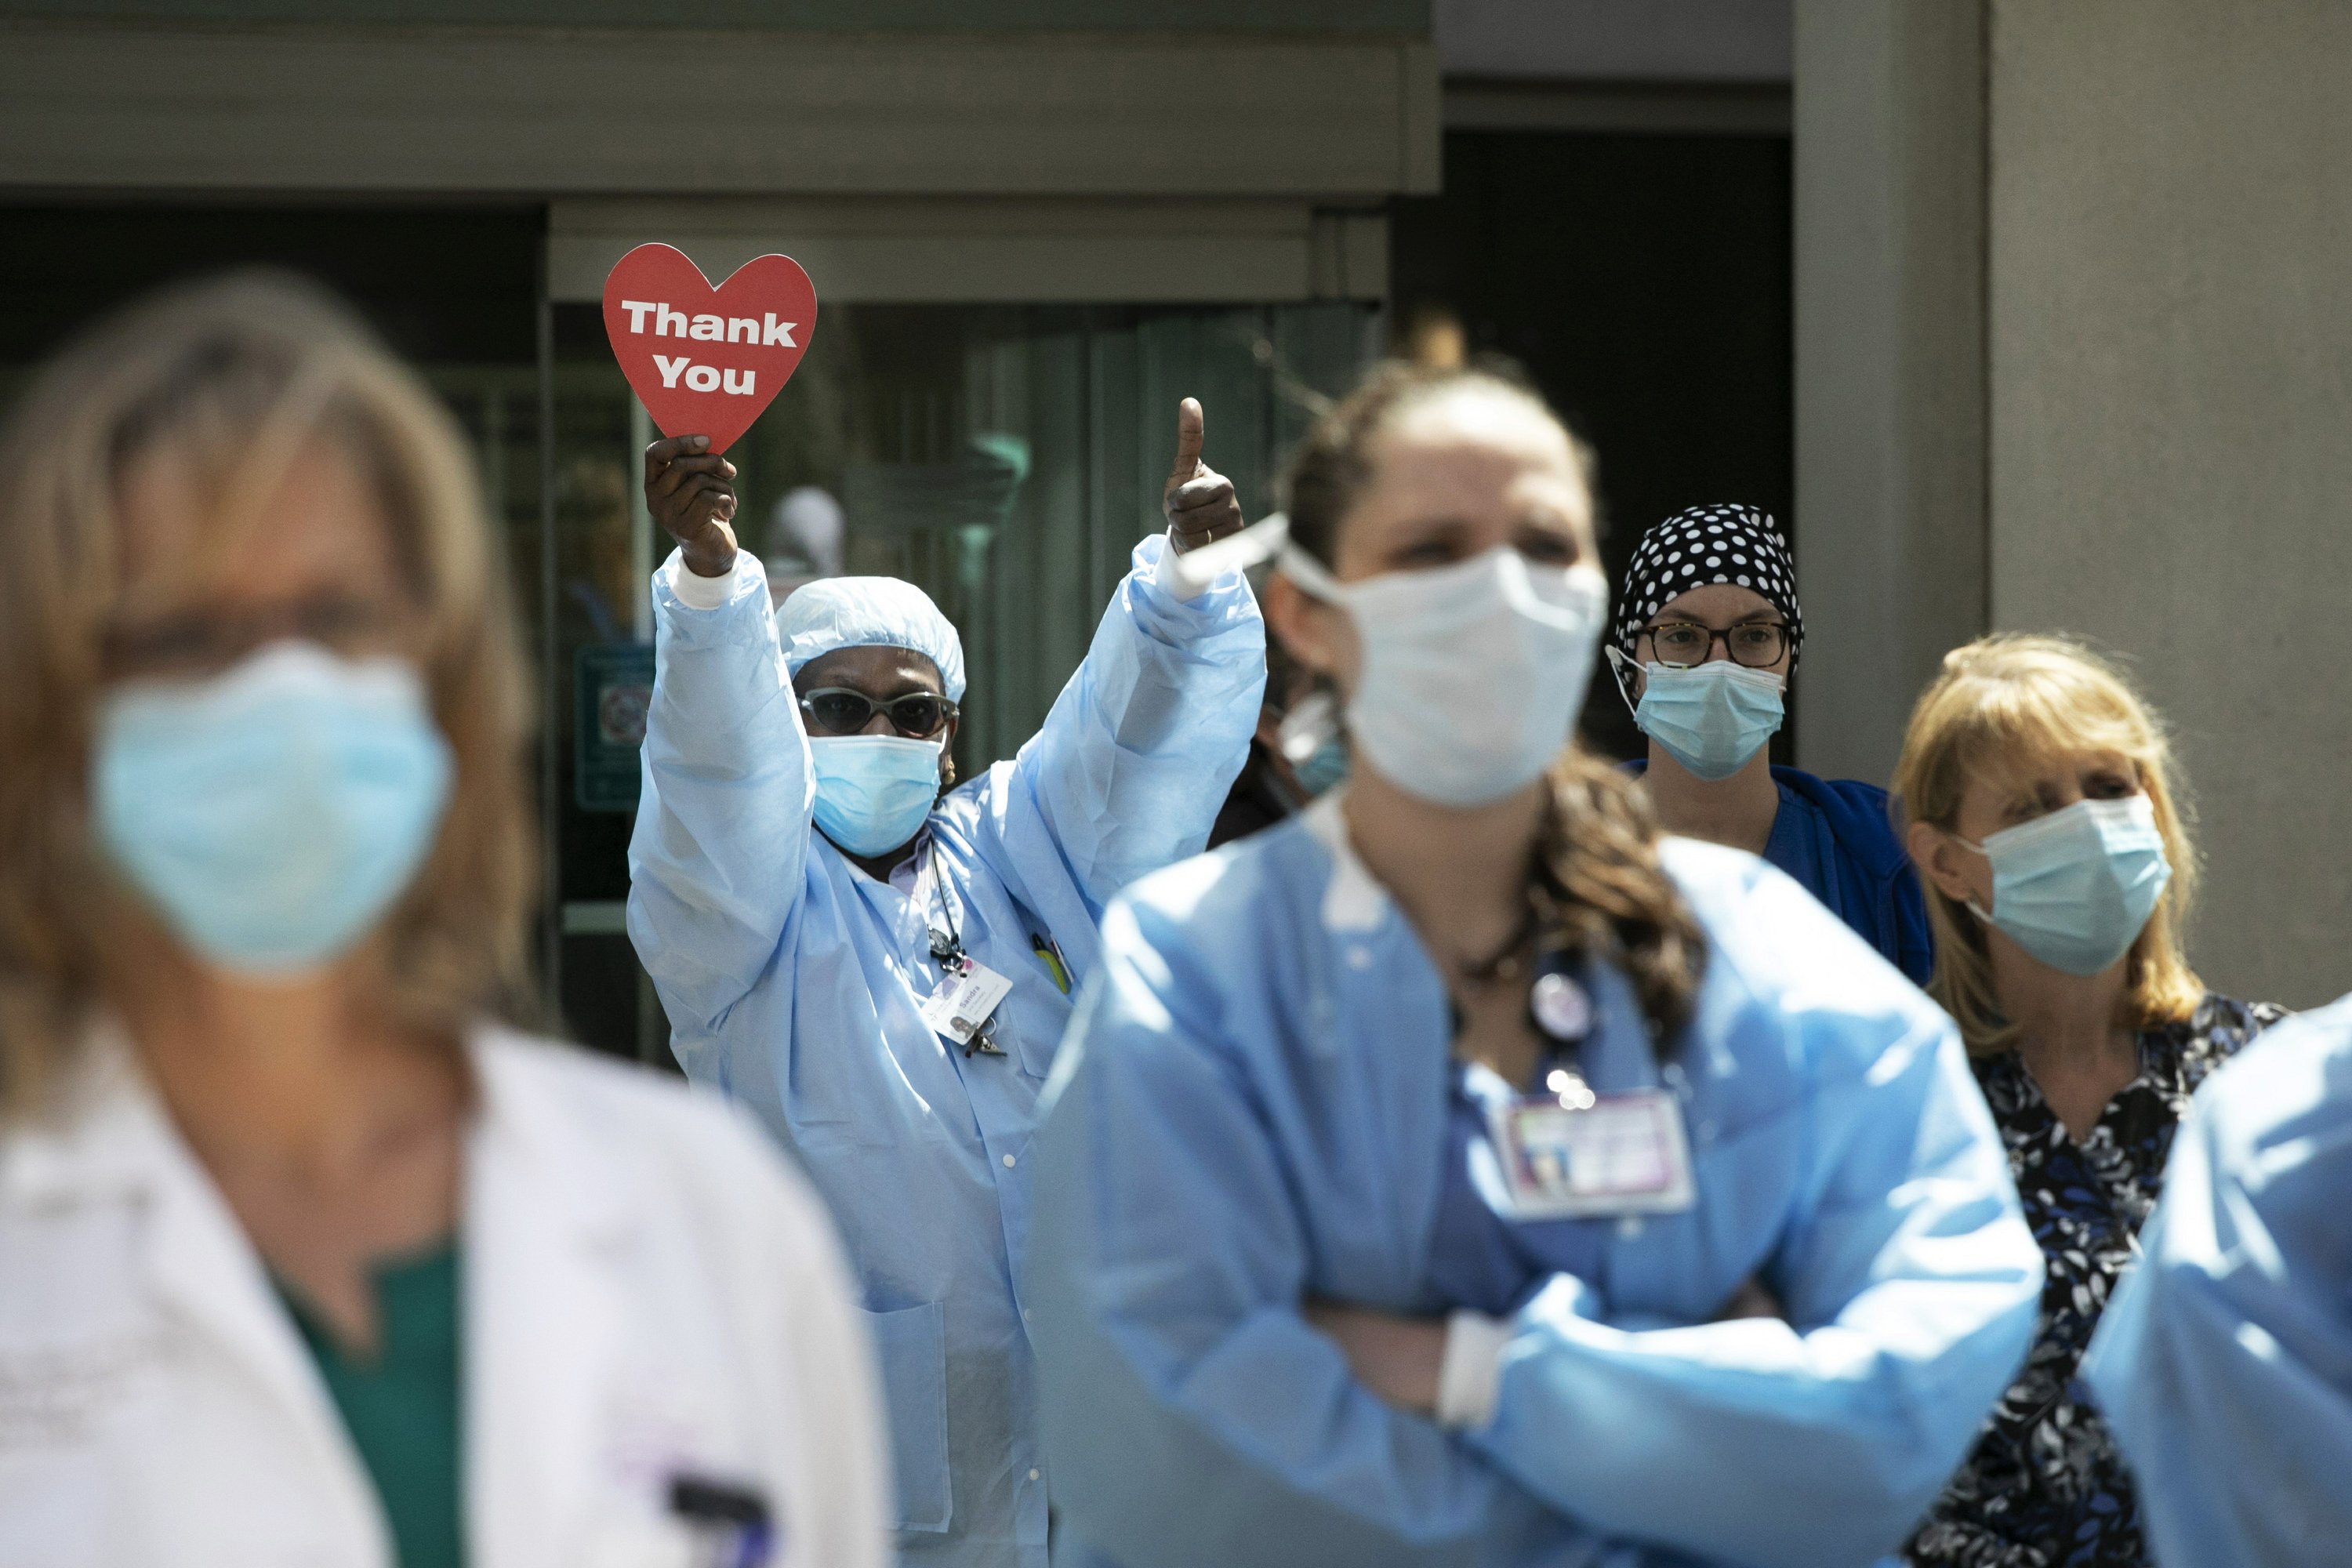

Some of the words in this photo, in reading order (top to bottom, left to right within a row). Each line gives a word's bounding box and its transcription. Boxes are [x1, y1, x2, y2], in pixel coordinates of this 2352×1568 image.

[621, 299, 798, 348] Thank
[652, 354, 756, 395] You
[960, 985, 980, 1008] Sandra
